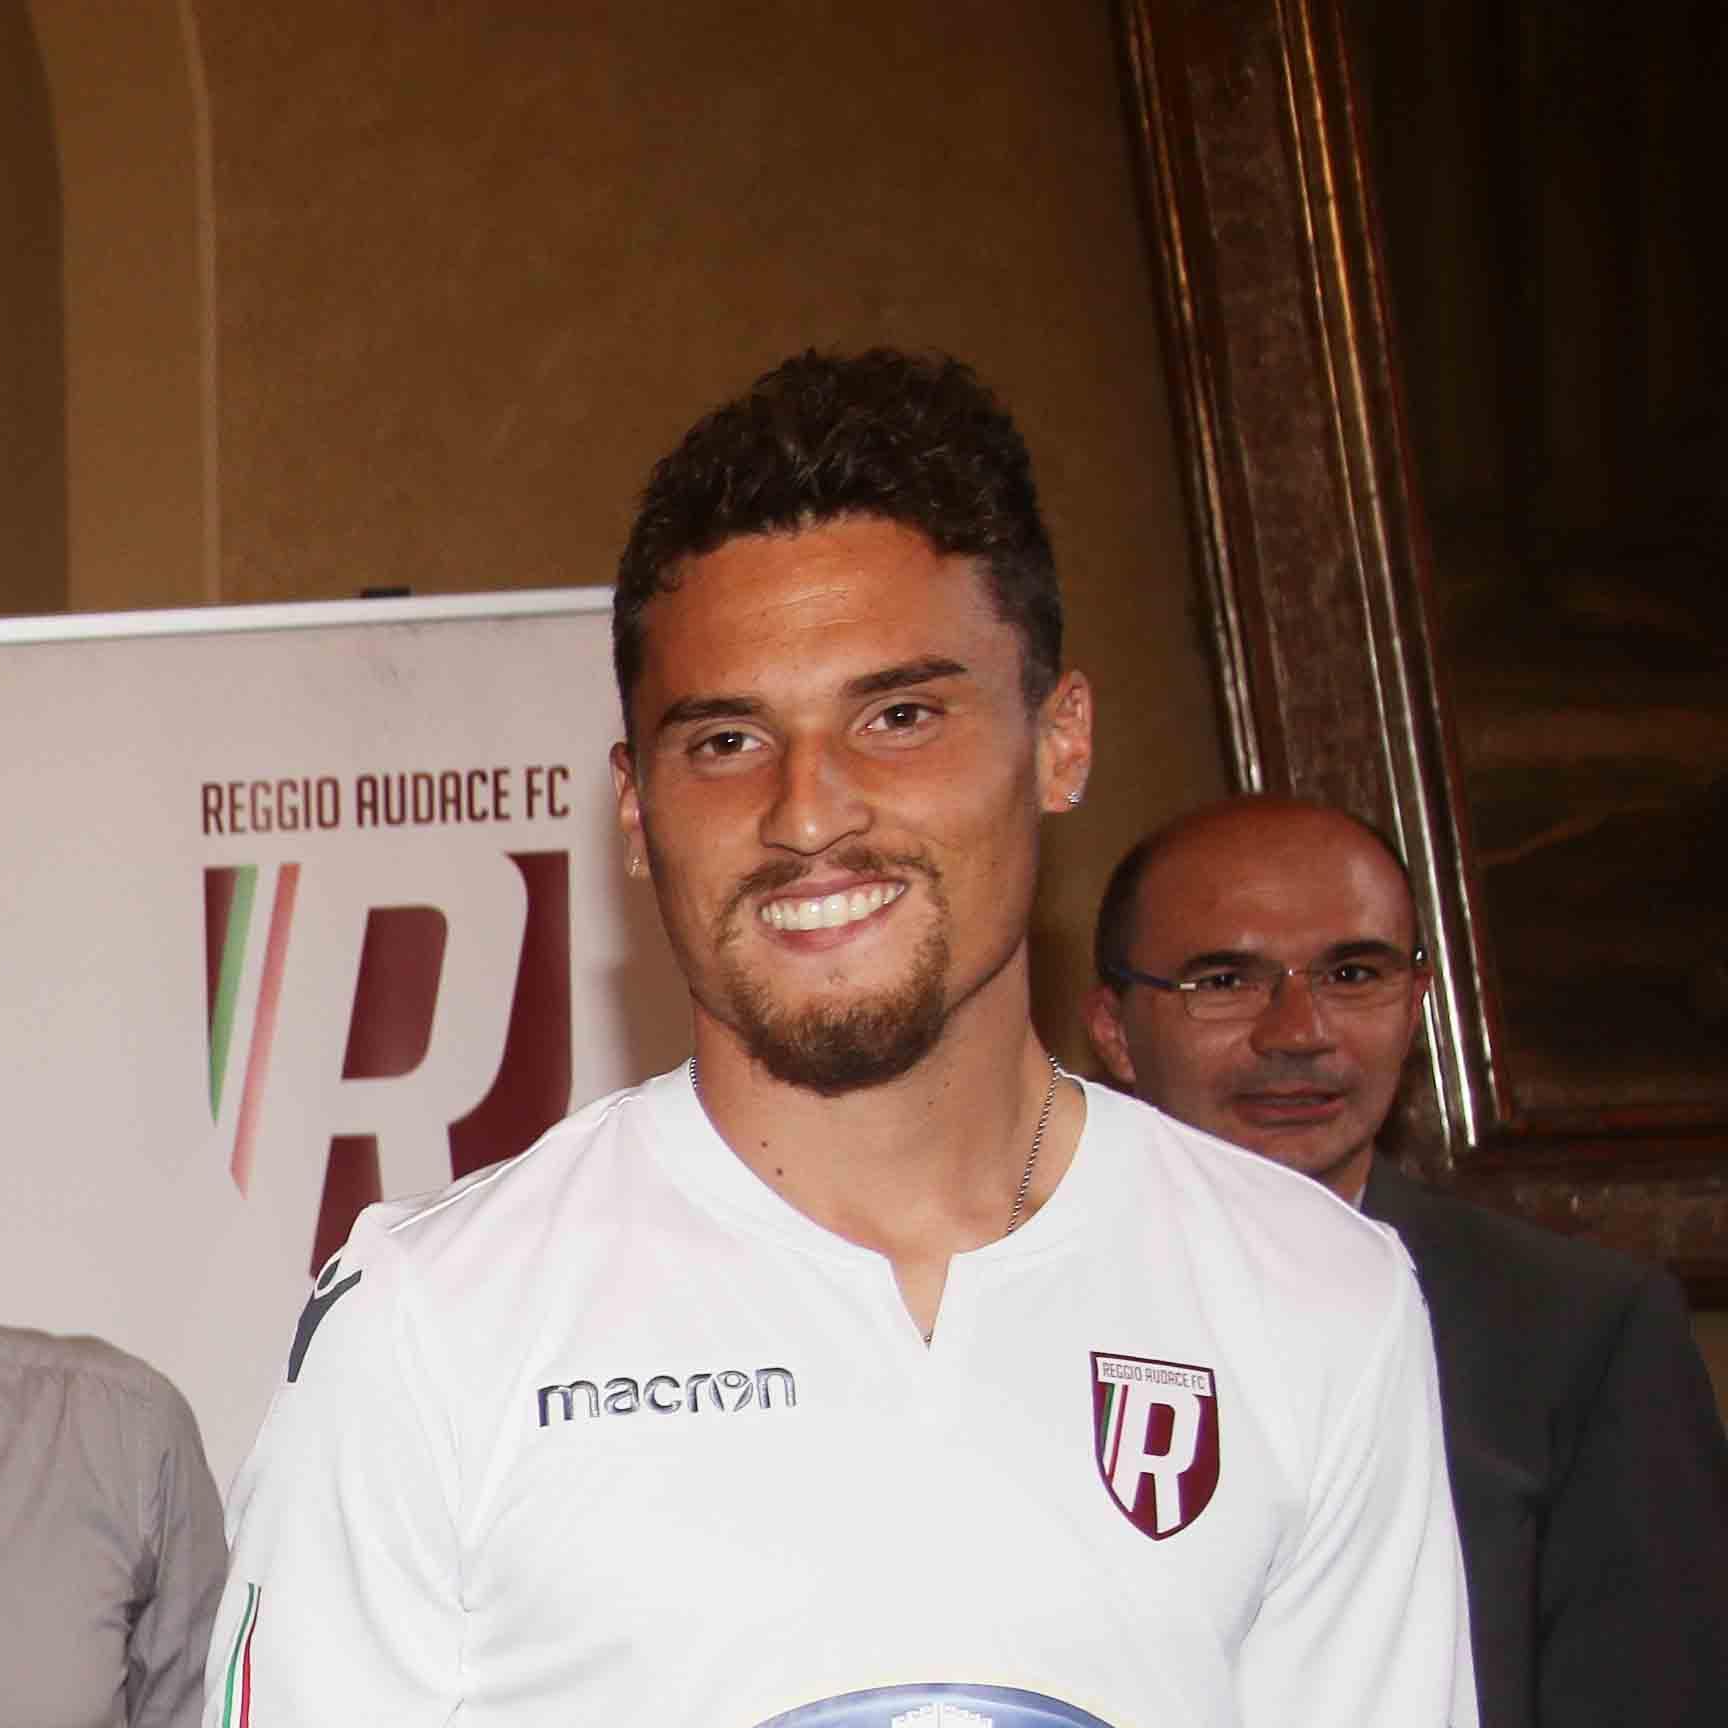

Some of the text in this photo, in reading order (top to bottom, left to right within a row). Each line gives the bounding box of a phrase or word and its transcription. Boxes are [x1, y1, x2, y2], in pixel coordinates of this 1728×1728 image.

[201, 764, 570, 836] REGGIO AUDACE FC
[536, 1366, 796, 1427] macron
[1101, 1361, 1206, 1391] REGGIO AUDACE FC
[1111, 1383, 1201, 1534] R
